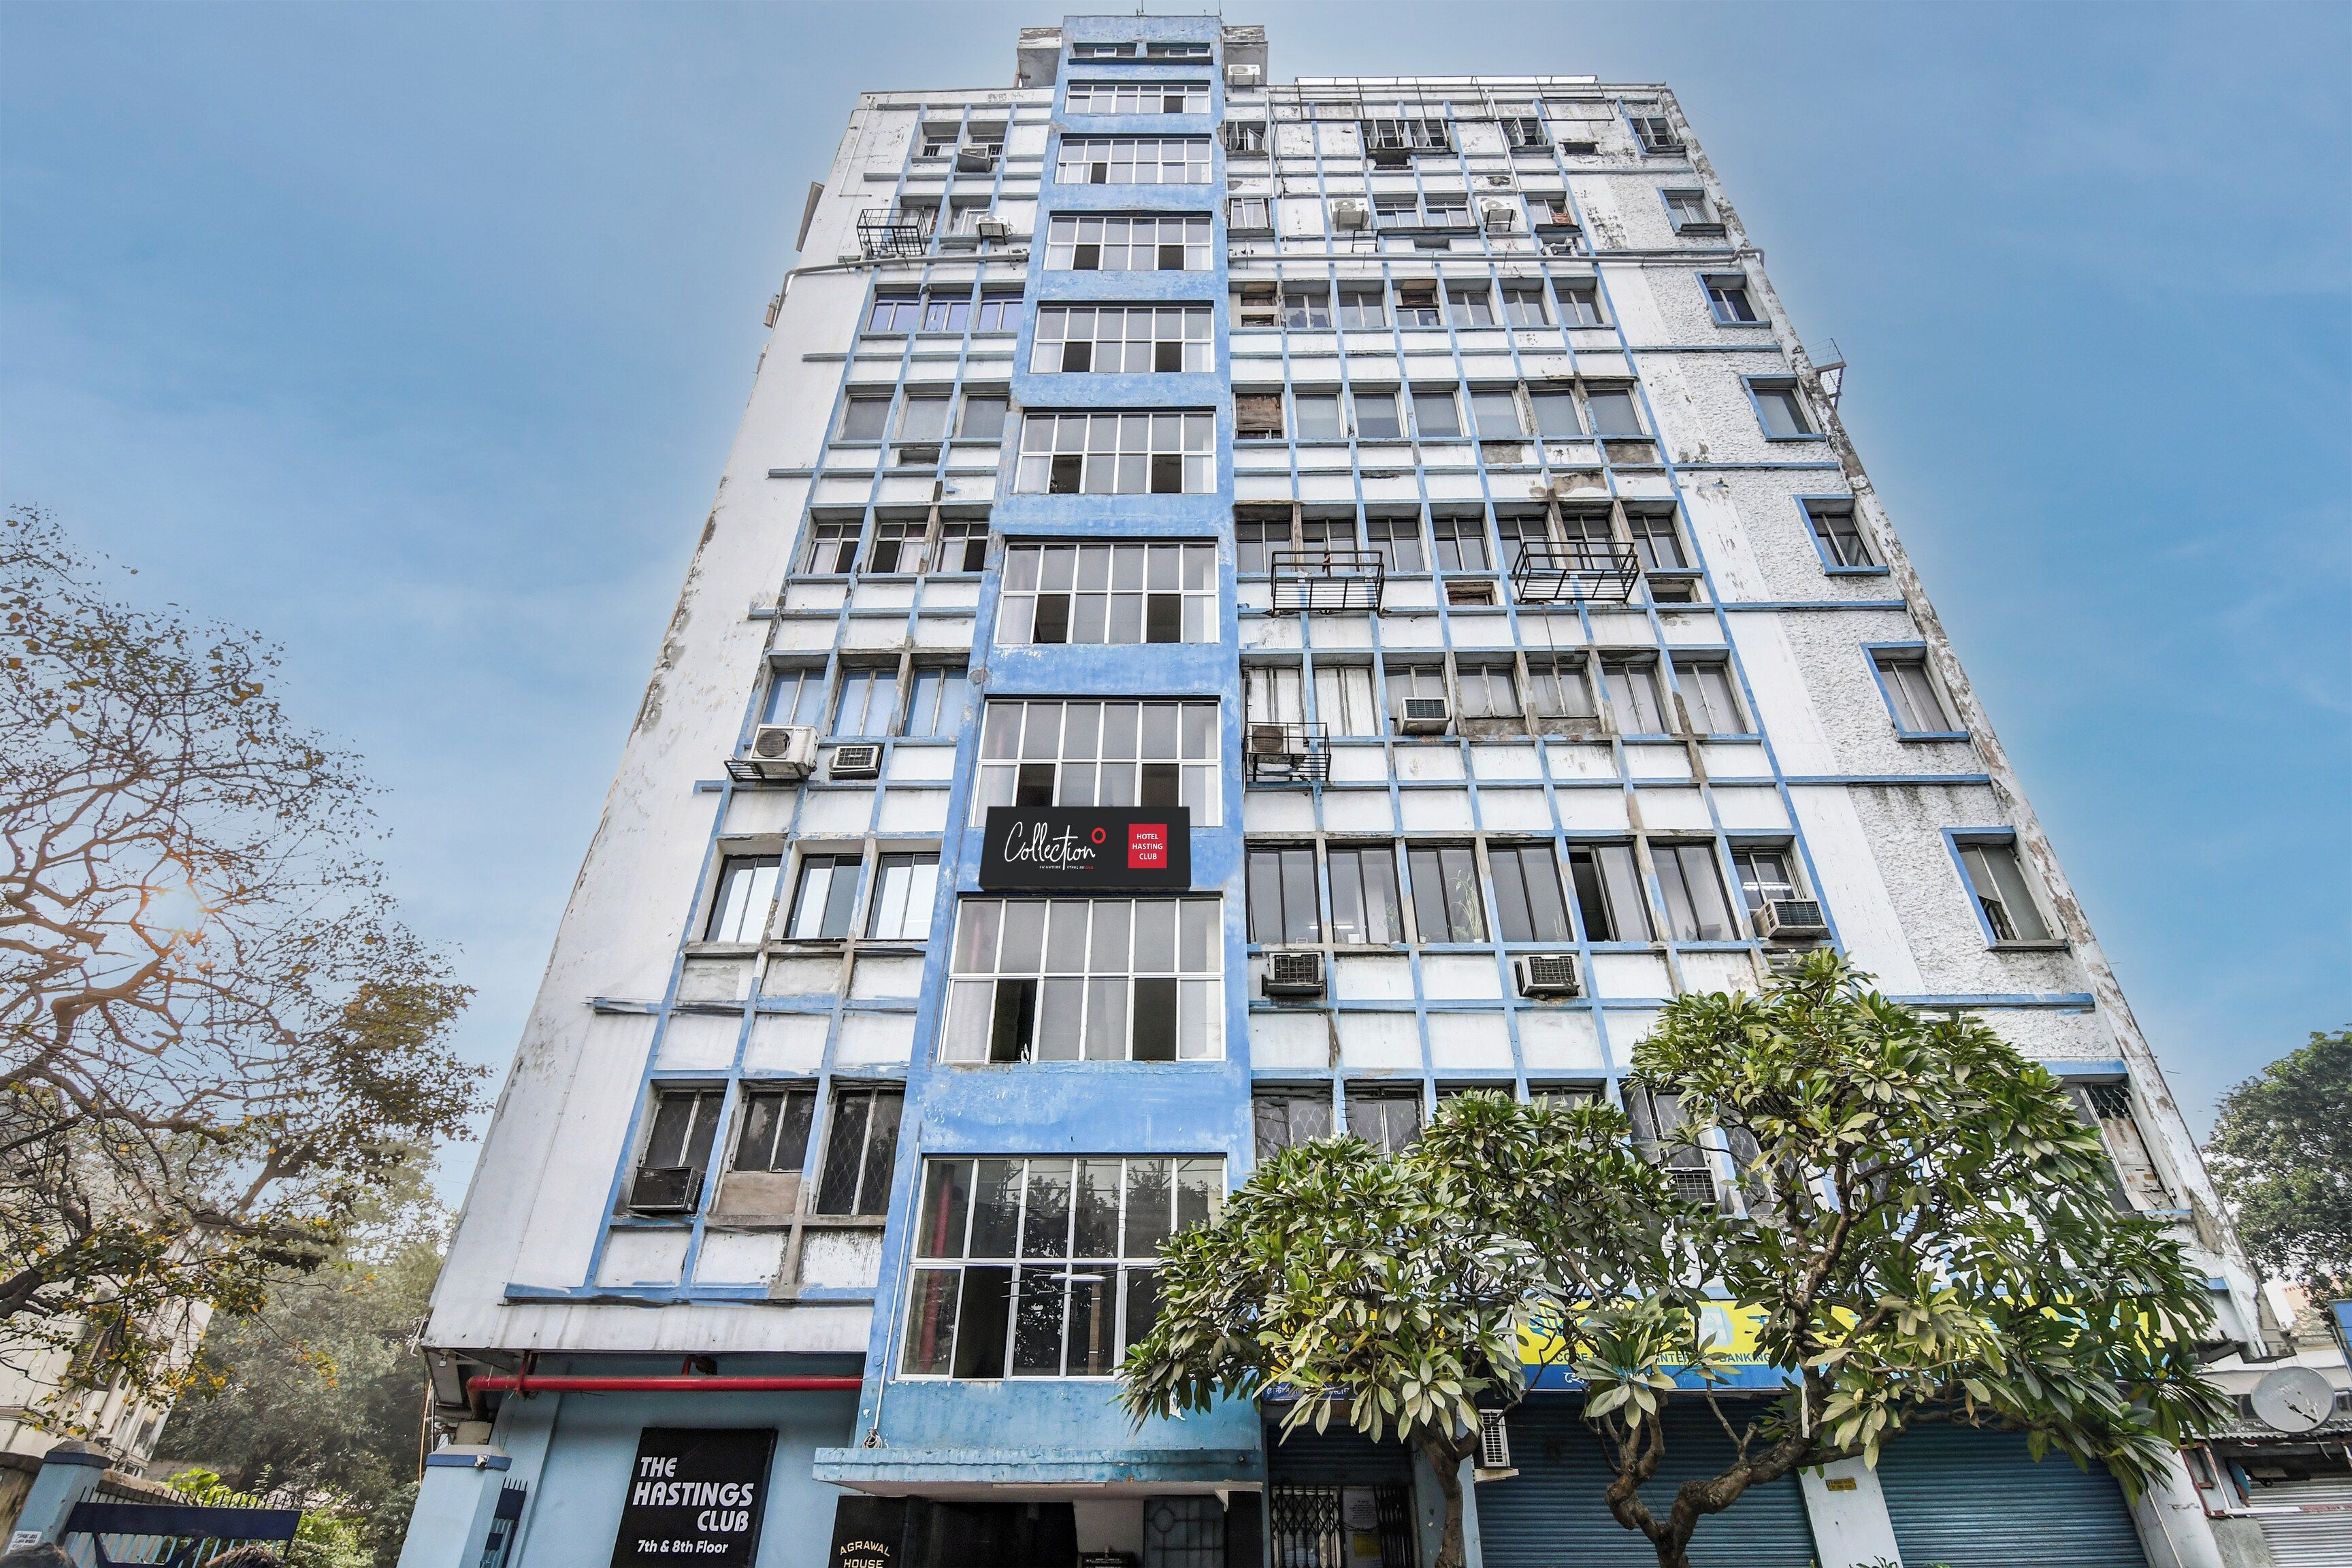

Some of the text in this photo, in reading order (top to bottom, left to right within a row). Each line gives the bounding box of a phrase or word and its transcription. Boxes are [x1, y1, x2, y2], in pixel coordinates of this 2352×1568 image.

[1004, 821, 1096, 870] Collection
[1556, 1353, 1588, 1362] COE
[640, 1456, 678, 1477] THE
[632, 1481, 754, 1507] HASTINGS
[697, 1510, 749, 1532] CLUB
[637, 1539, 728, 1554] 7th & 8th Floor
[839, 1541, 890, 1557] AGRAWAL
[843, 1558, 884, 1568] HOUSE
